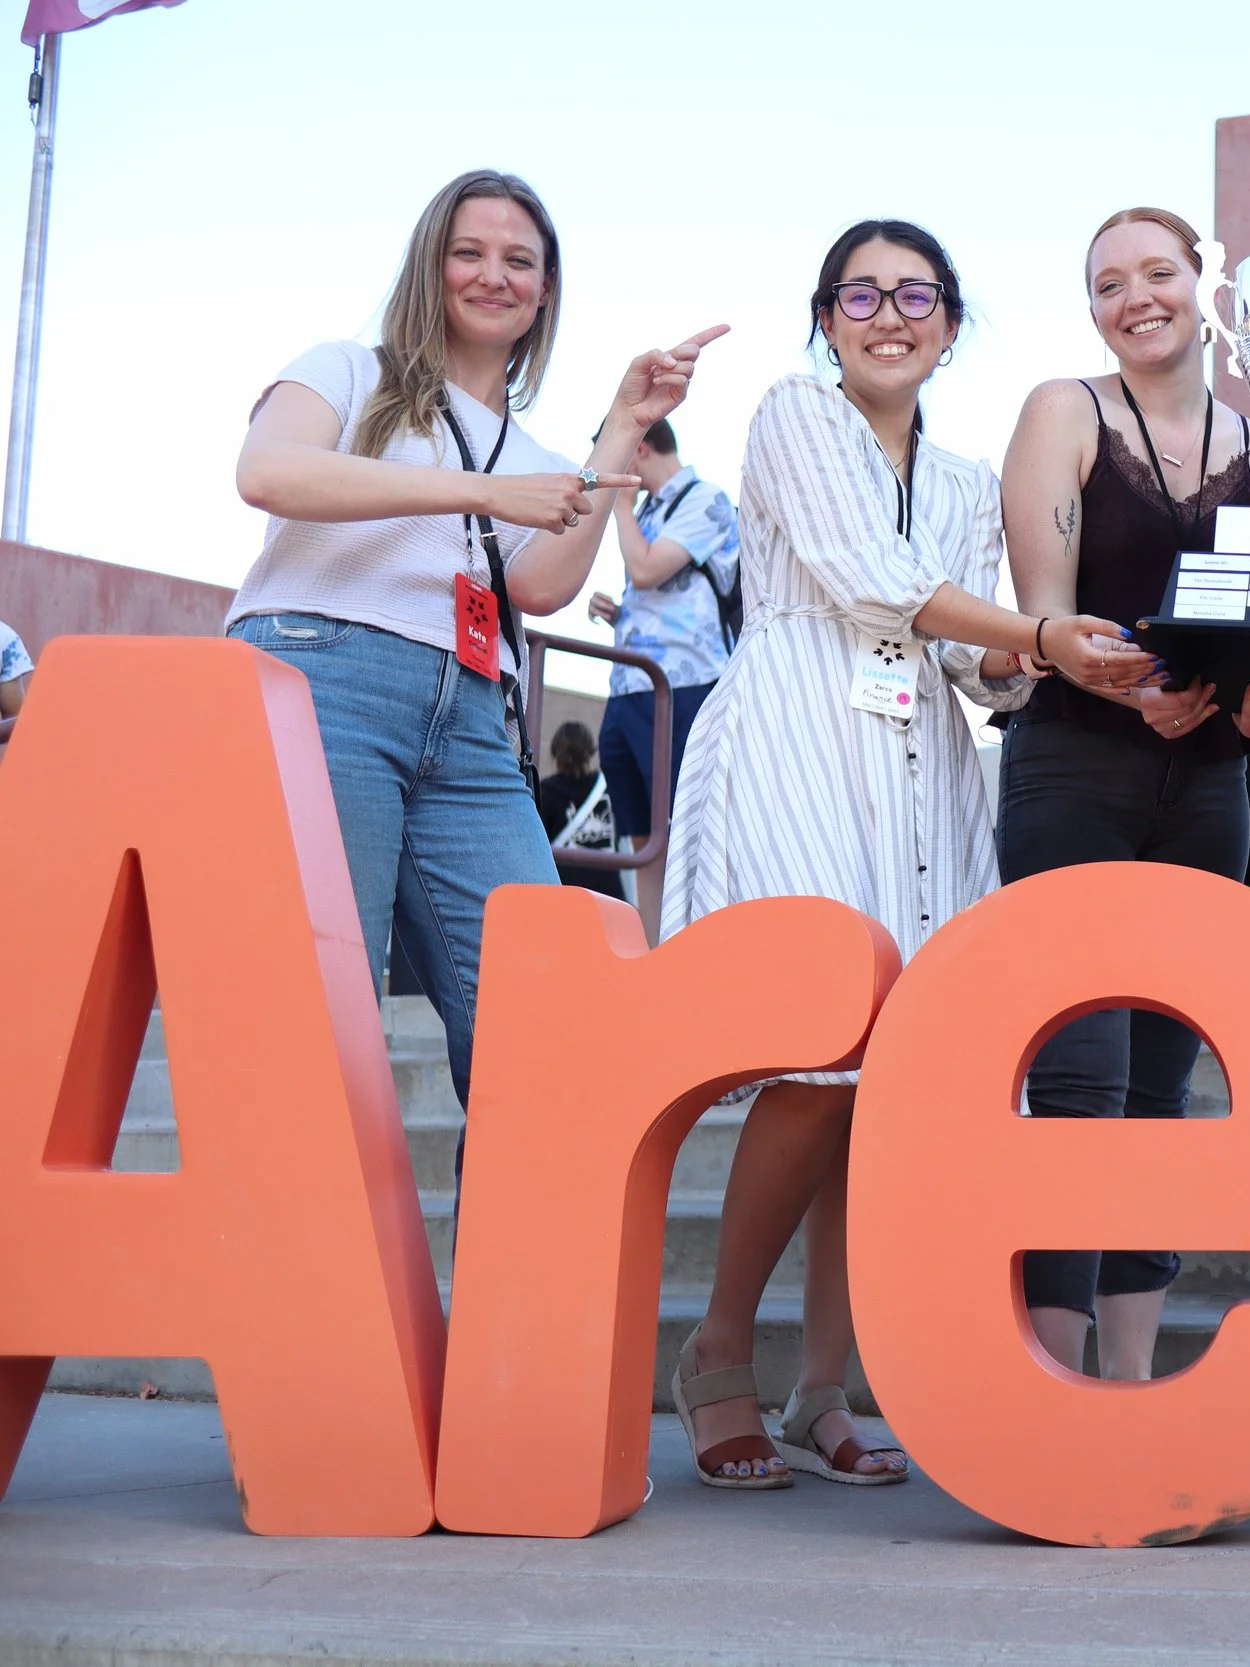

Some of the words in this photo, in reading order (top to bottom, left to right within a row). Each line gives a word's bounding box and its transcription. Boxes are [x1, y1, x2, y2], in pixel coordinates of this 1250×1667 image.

[468, 625, 487, 644] Kate
[862, 665, 909, 685] Lissette
[863, 688, 892, 703] Finance
[875, 683, 893, 692] Zarco
